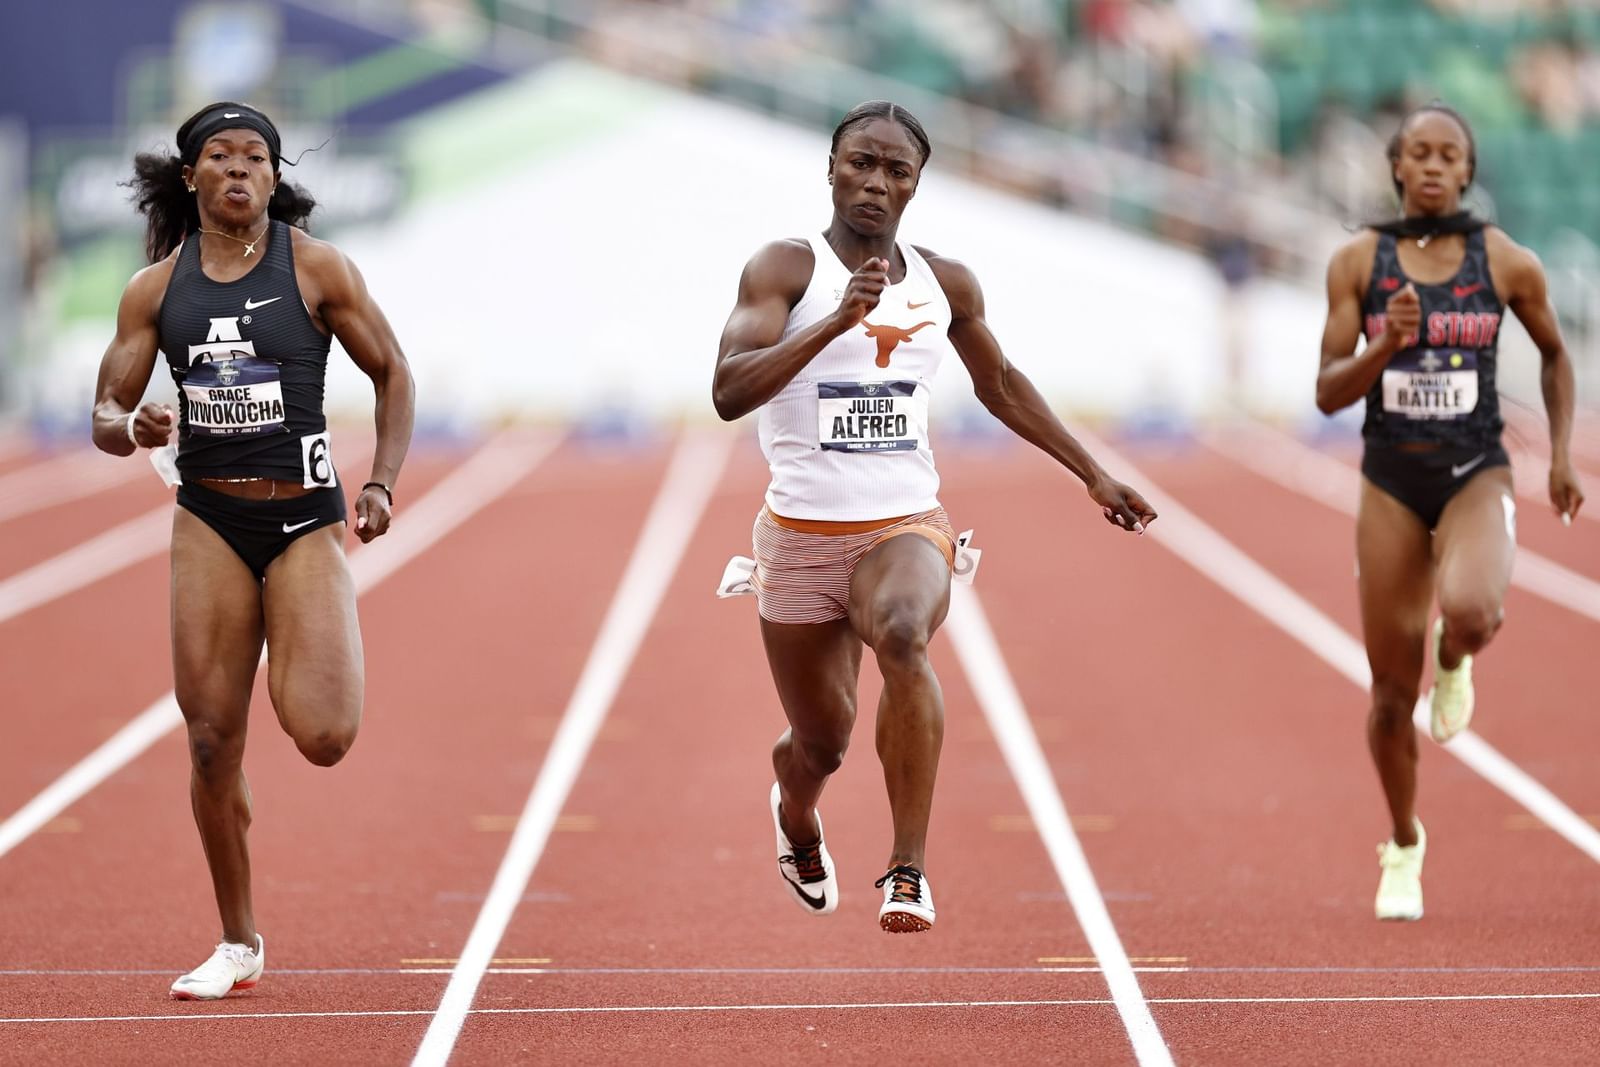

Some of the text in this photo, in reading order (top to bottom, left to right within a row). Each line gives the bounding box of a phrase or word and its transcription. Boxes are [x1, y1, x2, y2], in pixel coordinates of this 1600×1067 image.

[208, 388, 252, 401] GRACE
[1397, 388, 1463, 408] BATTLE
[189, 399, 284, 425] NWOKOCHA
[848, 399, 893, 414] JULIEN
[832, 414, 907, 439] ALFRED
[309, 438, 331, 485] 6
